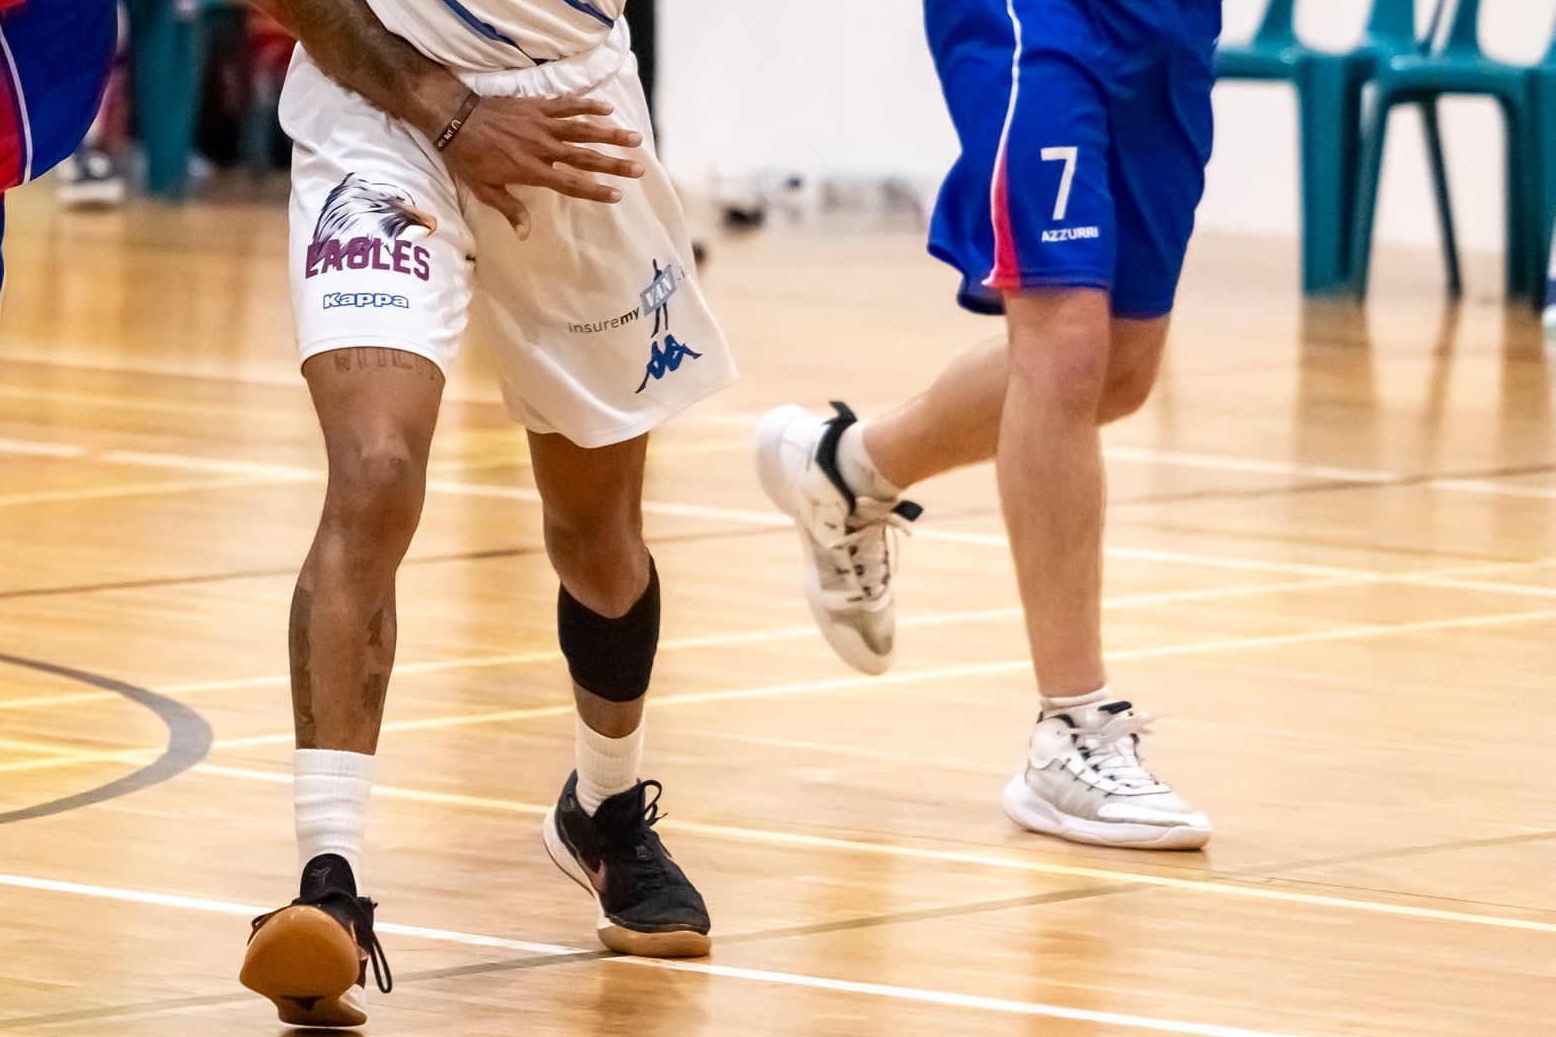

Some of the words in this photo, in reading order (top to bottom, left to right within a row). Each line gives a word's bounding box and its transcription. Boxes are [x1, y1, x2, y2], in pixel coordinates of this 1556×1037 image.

[1040, 146, 1077, 220] 7
[1041, 226, 1099, 242] AZZURRI
[323, 292, 409, 309] Kappa
